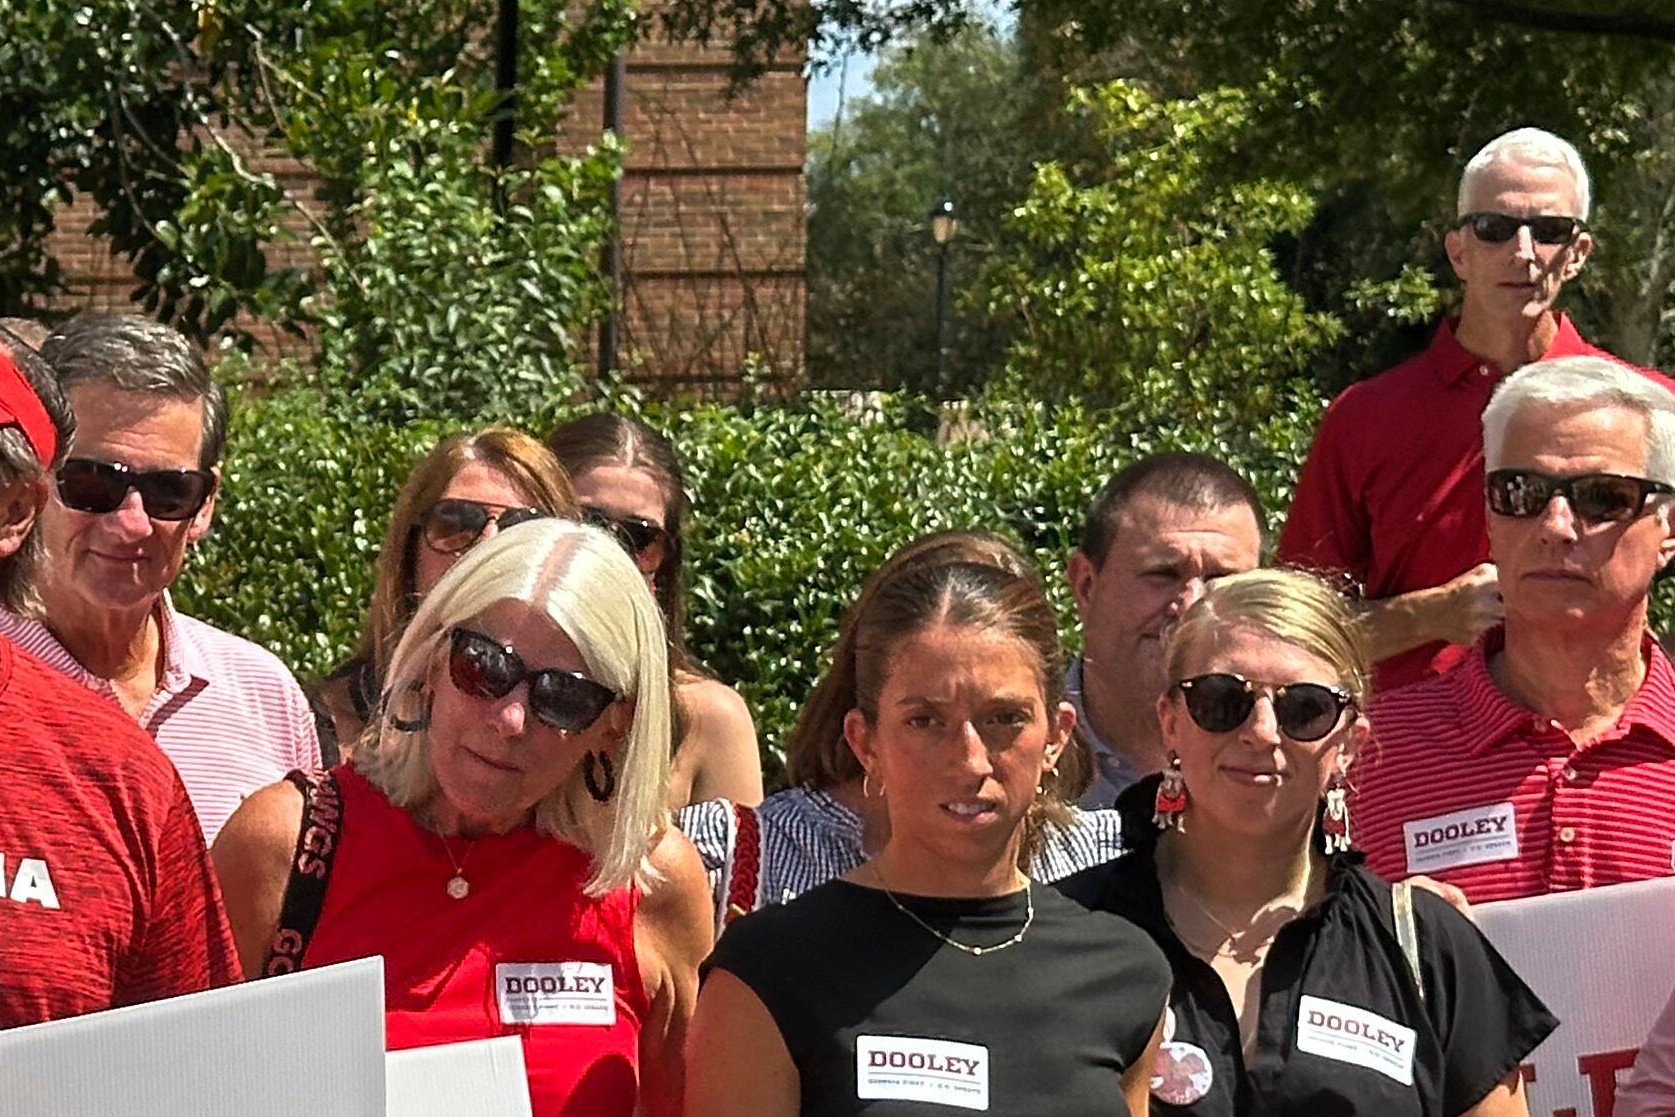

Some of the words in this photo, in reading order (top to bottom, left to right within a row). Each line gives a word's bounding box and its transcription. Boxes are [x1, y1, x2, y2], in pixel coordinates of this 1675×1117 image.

[1414, 815, 1508, 848] DOOLEY
[505, 976, 605, 994] DOOLEY
[1307, 1010, 1405, 1053] DOOLEY
[868, 1050, 980, 1076] DOOLEY
